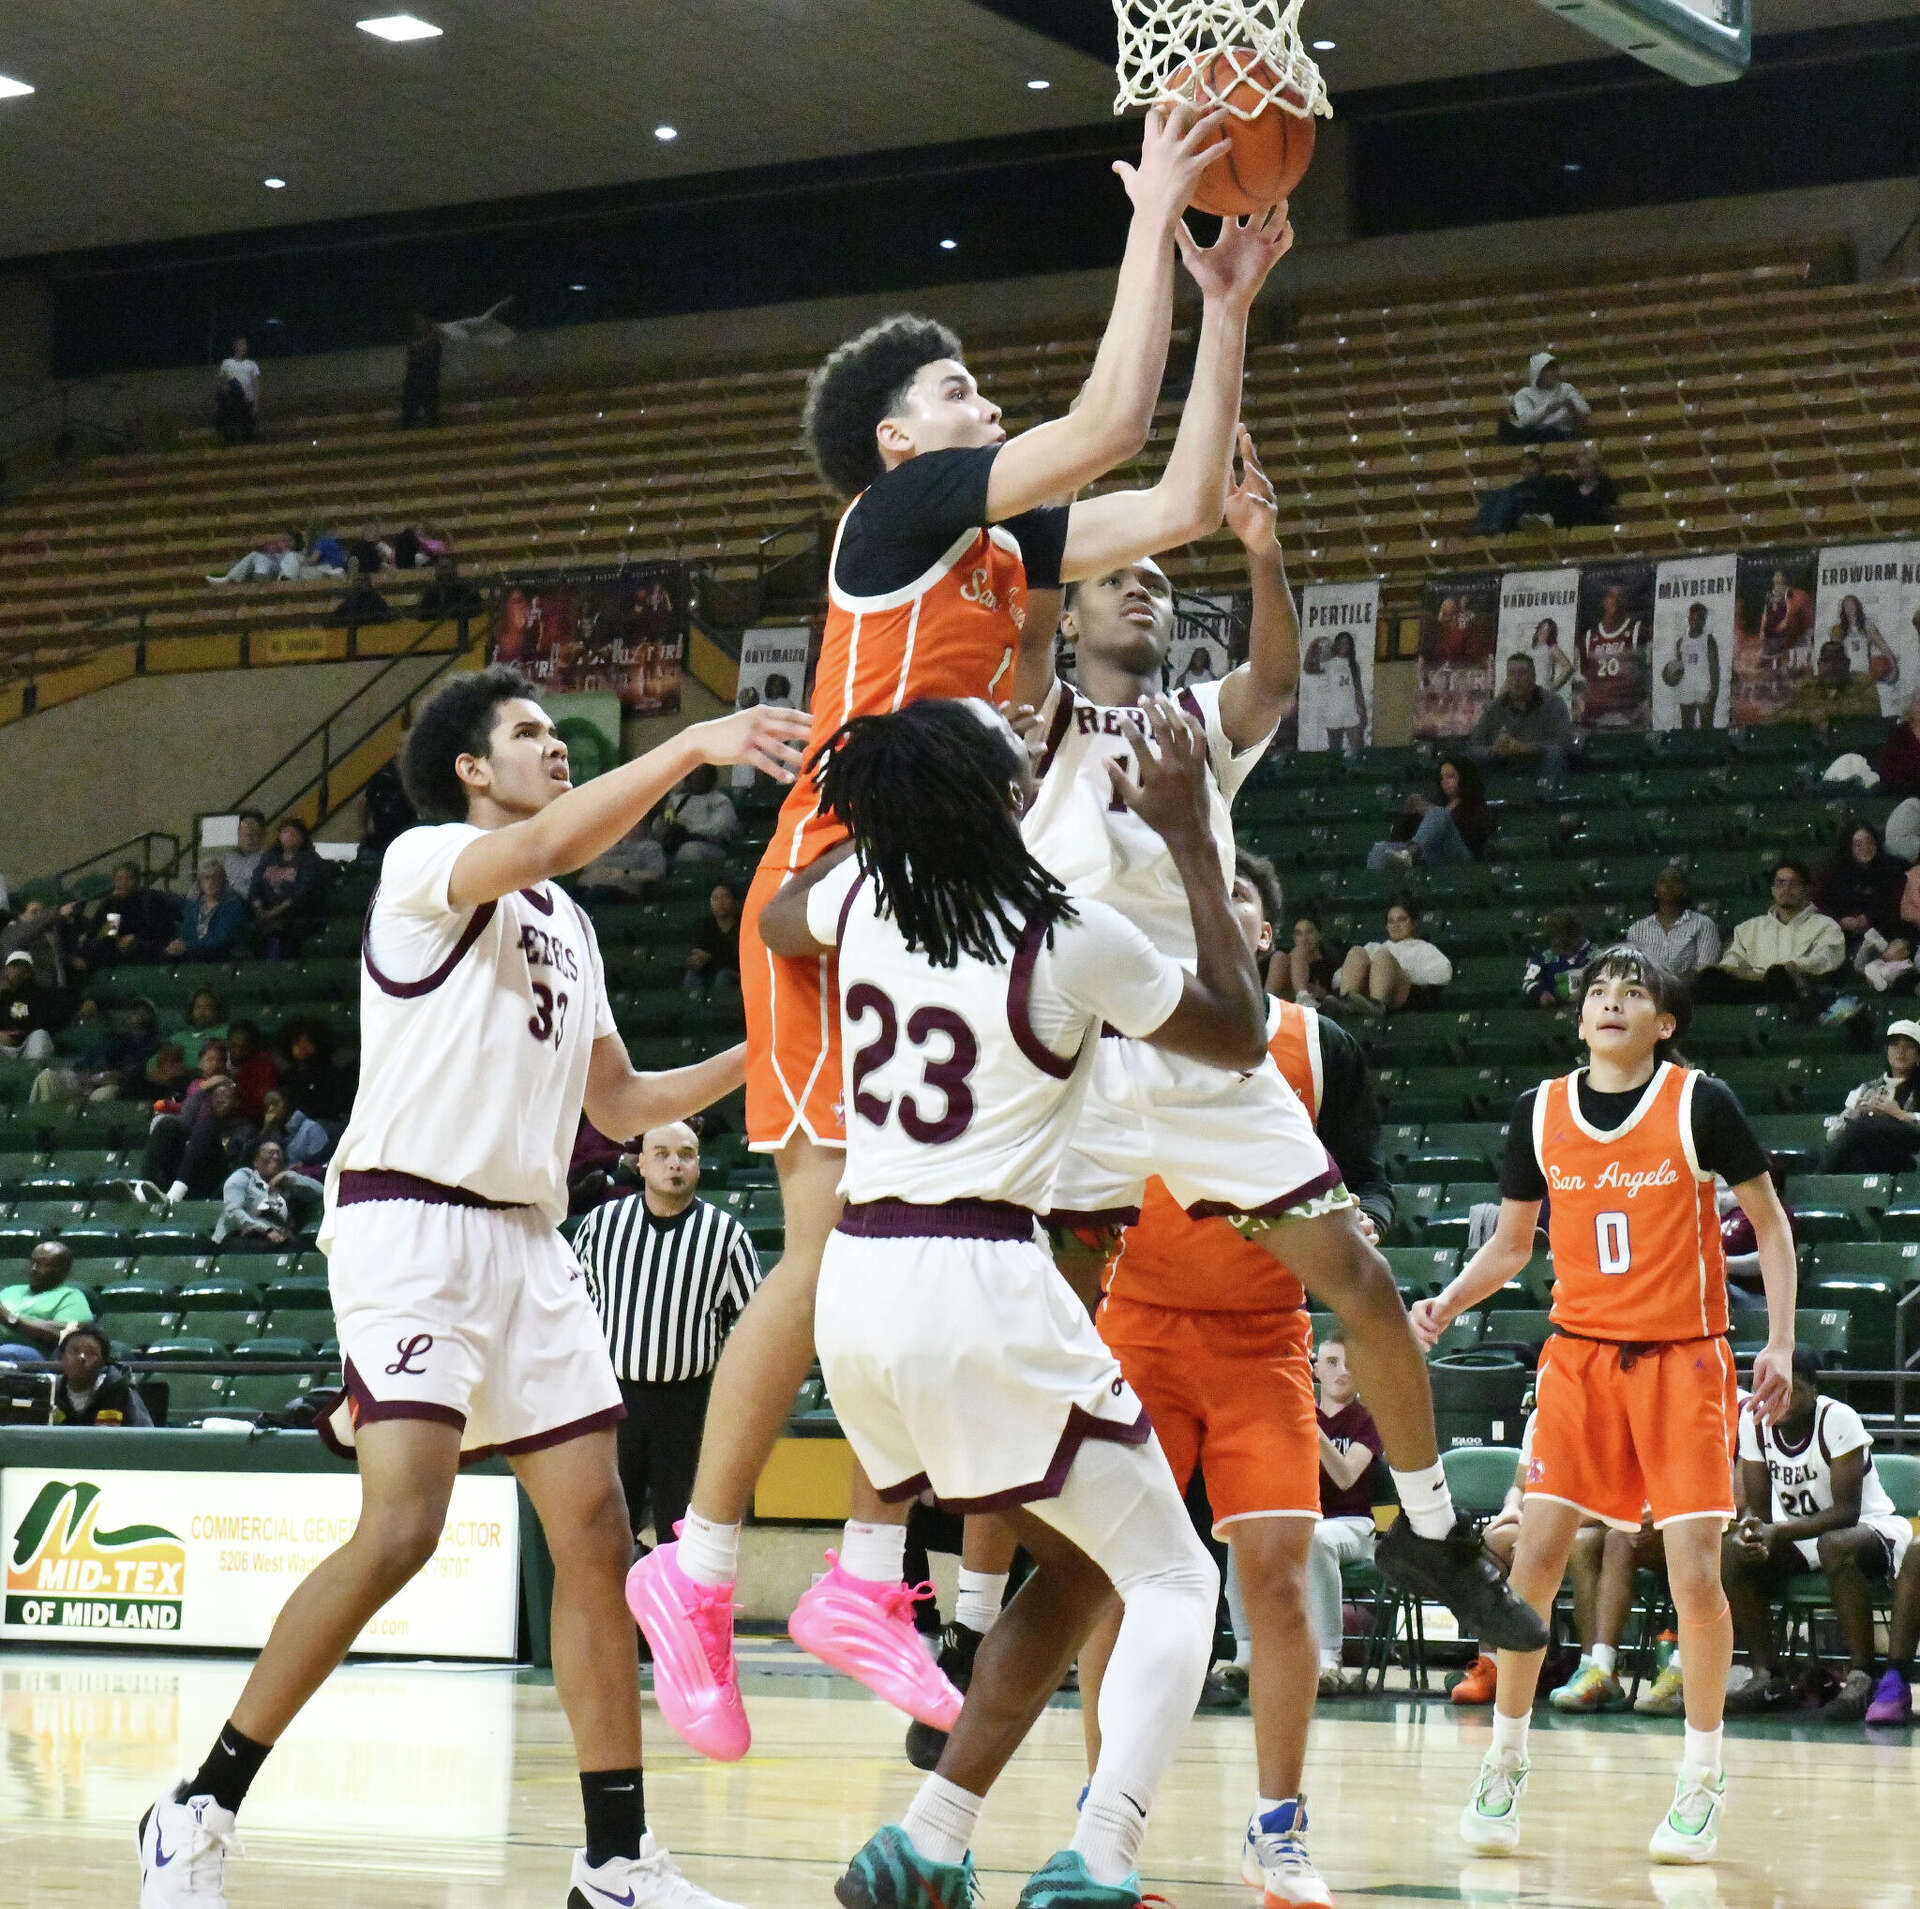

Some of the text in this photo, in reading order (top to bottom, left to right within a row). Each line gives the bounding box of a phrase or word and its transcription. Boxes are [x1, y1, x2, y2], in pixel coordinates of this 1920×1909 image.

[1658, 577, 1734, 599] MAYBERRY
[1309, 602, 1372, 628] PERTILE
[845, 978, 982, 1145] 23
[1549, 1158, 1680, 1198] San Angelo
[1594, 1210, 1632, 1275] 0
[1780, 1489, 1820, 1518] 20
[191, 1515, 299, 1543] COMMERCIAL
[37, 1559, 183, 1594] MID-TEX
[219, 1551, 249, 1574] 5206
[253, 1551, 284, 1574] West
[22, 1600, 178, 1630] OF MIDLAND
